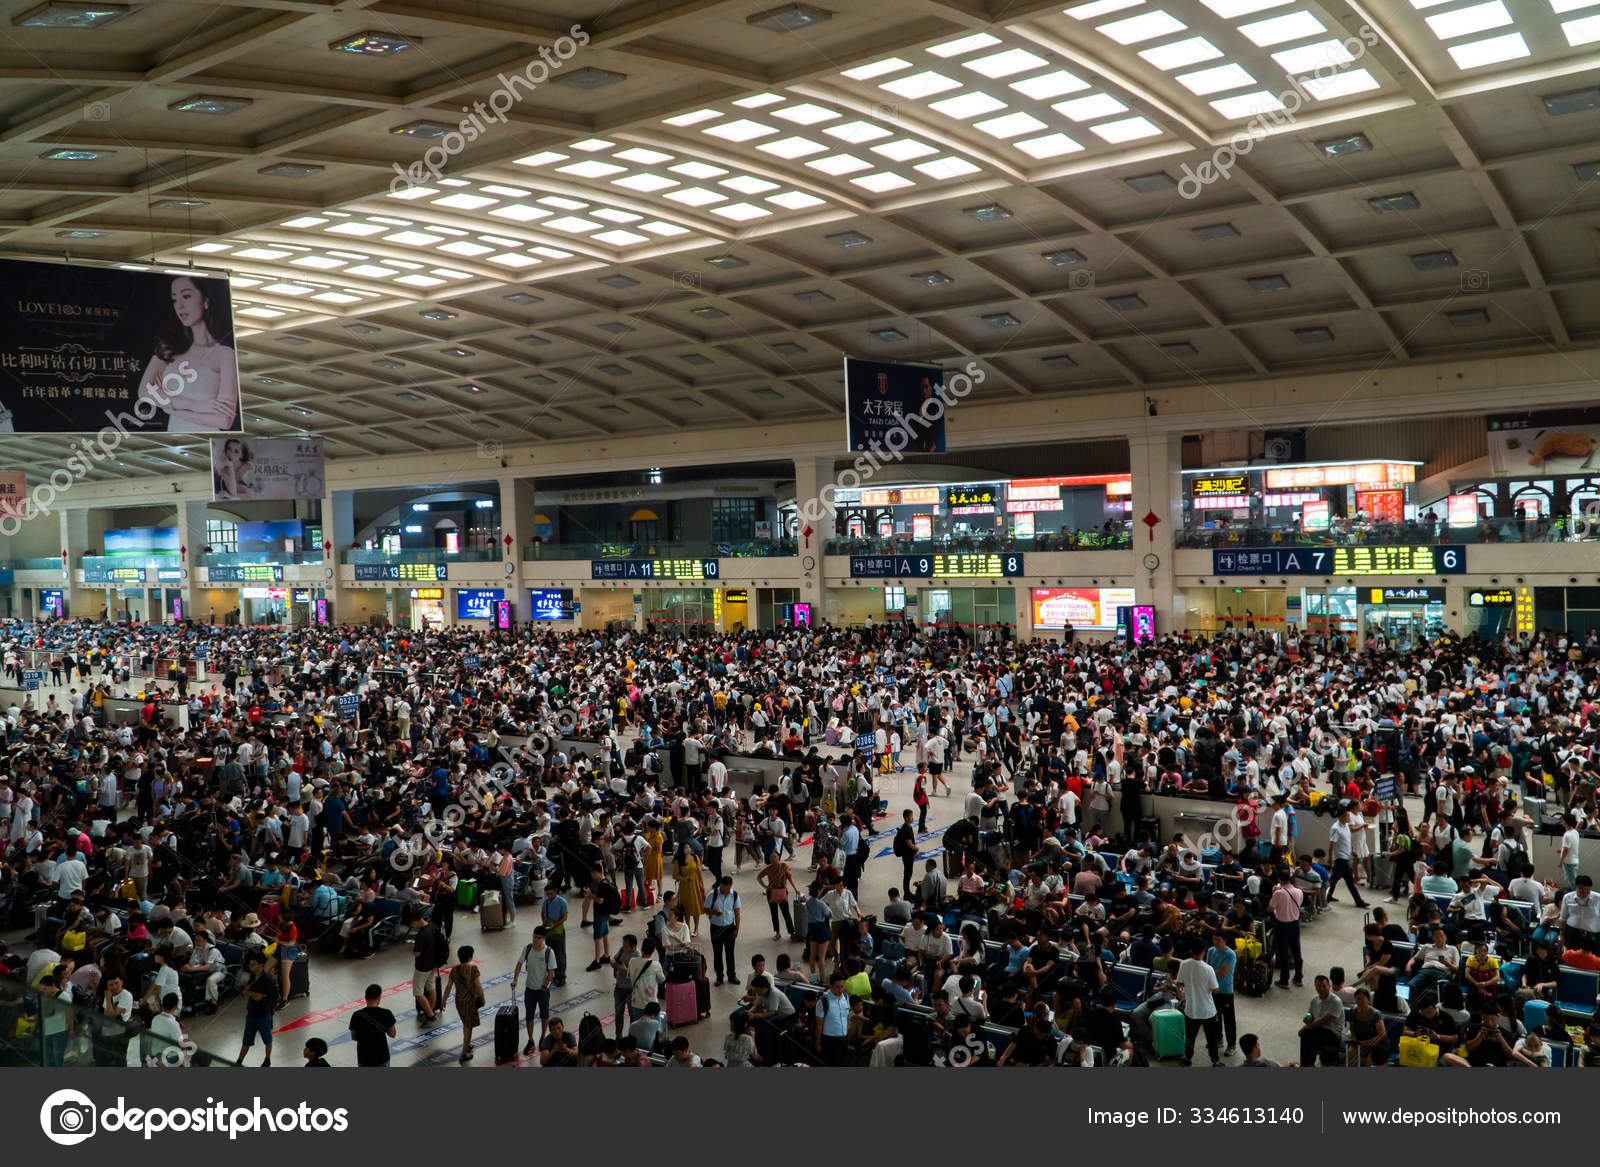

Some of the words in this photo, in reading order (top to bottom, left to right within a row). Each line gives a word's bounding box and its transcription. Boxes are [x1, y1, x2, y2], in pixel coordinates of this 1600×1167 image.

[1, 353, 141, 373] 比利时钻石切工世家
[863, 399, 904, 416] 太子家居
[867, 559, 891, 568] 检票口
[1008, 557, 1018, 572] 8
[1237, 554, 1272, 564] 检票口
[1285, 553, 1301, 570] A
[1312, 552, 1326, 570] 7
[1443, 551, 1457, 568] 6
[381, 568, 389, 577] A
[390, 567, 399, 578] 13
[436, 567, 446, 577] 12
[628, 563, 637, 576] A
[641, 563, 651, 576] 11
[704, 562, 716, 575] 10
[900, 560, 912, 574] A
[919, 558, 928, 573] 9
[236, 569, 244, 579] 15
[274, 569, 282, 579] 14
